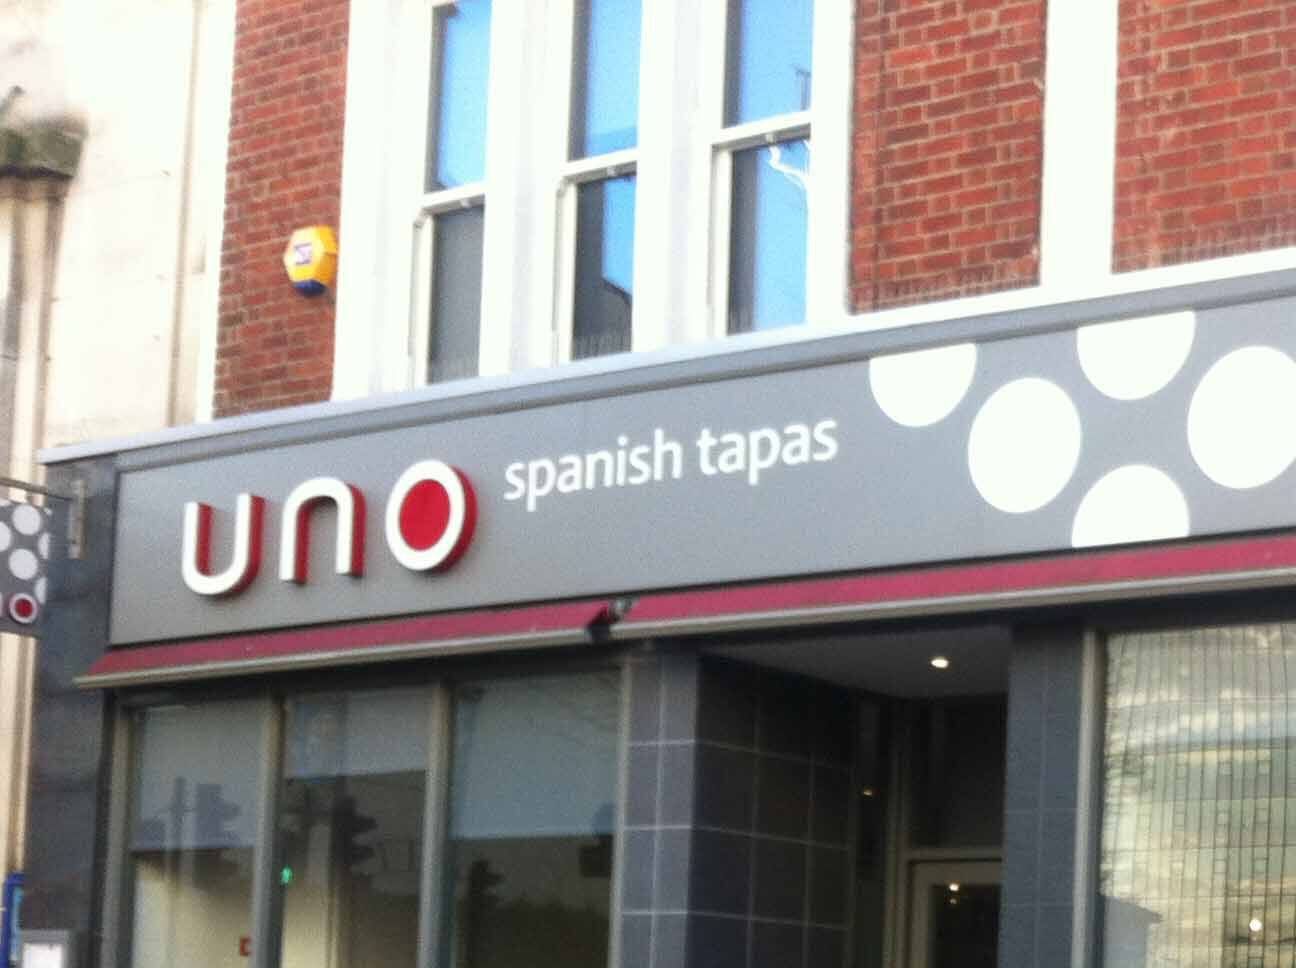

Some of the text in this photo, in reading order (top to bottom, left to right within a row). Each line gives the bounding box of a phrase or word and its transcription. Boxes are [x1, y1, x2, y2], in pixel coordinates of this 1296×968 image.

[503, 418, 839, 512] spanish tapas
[181, 459, 478, 596] uno
